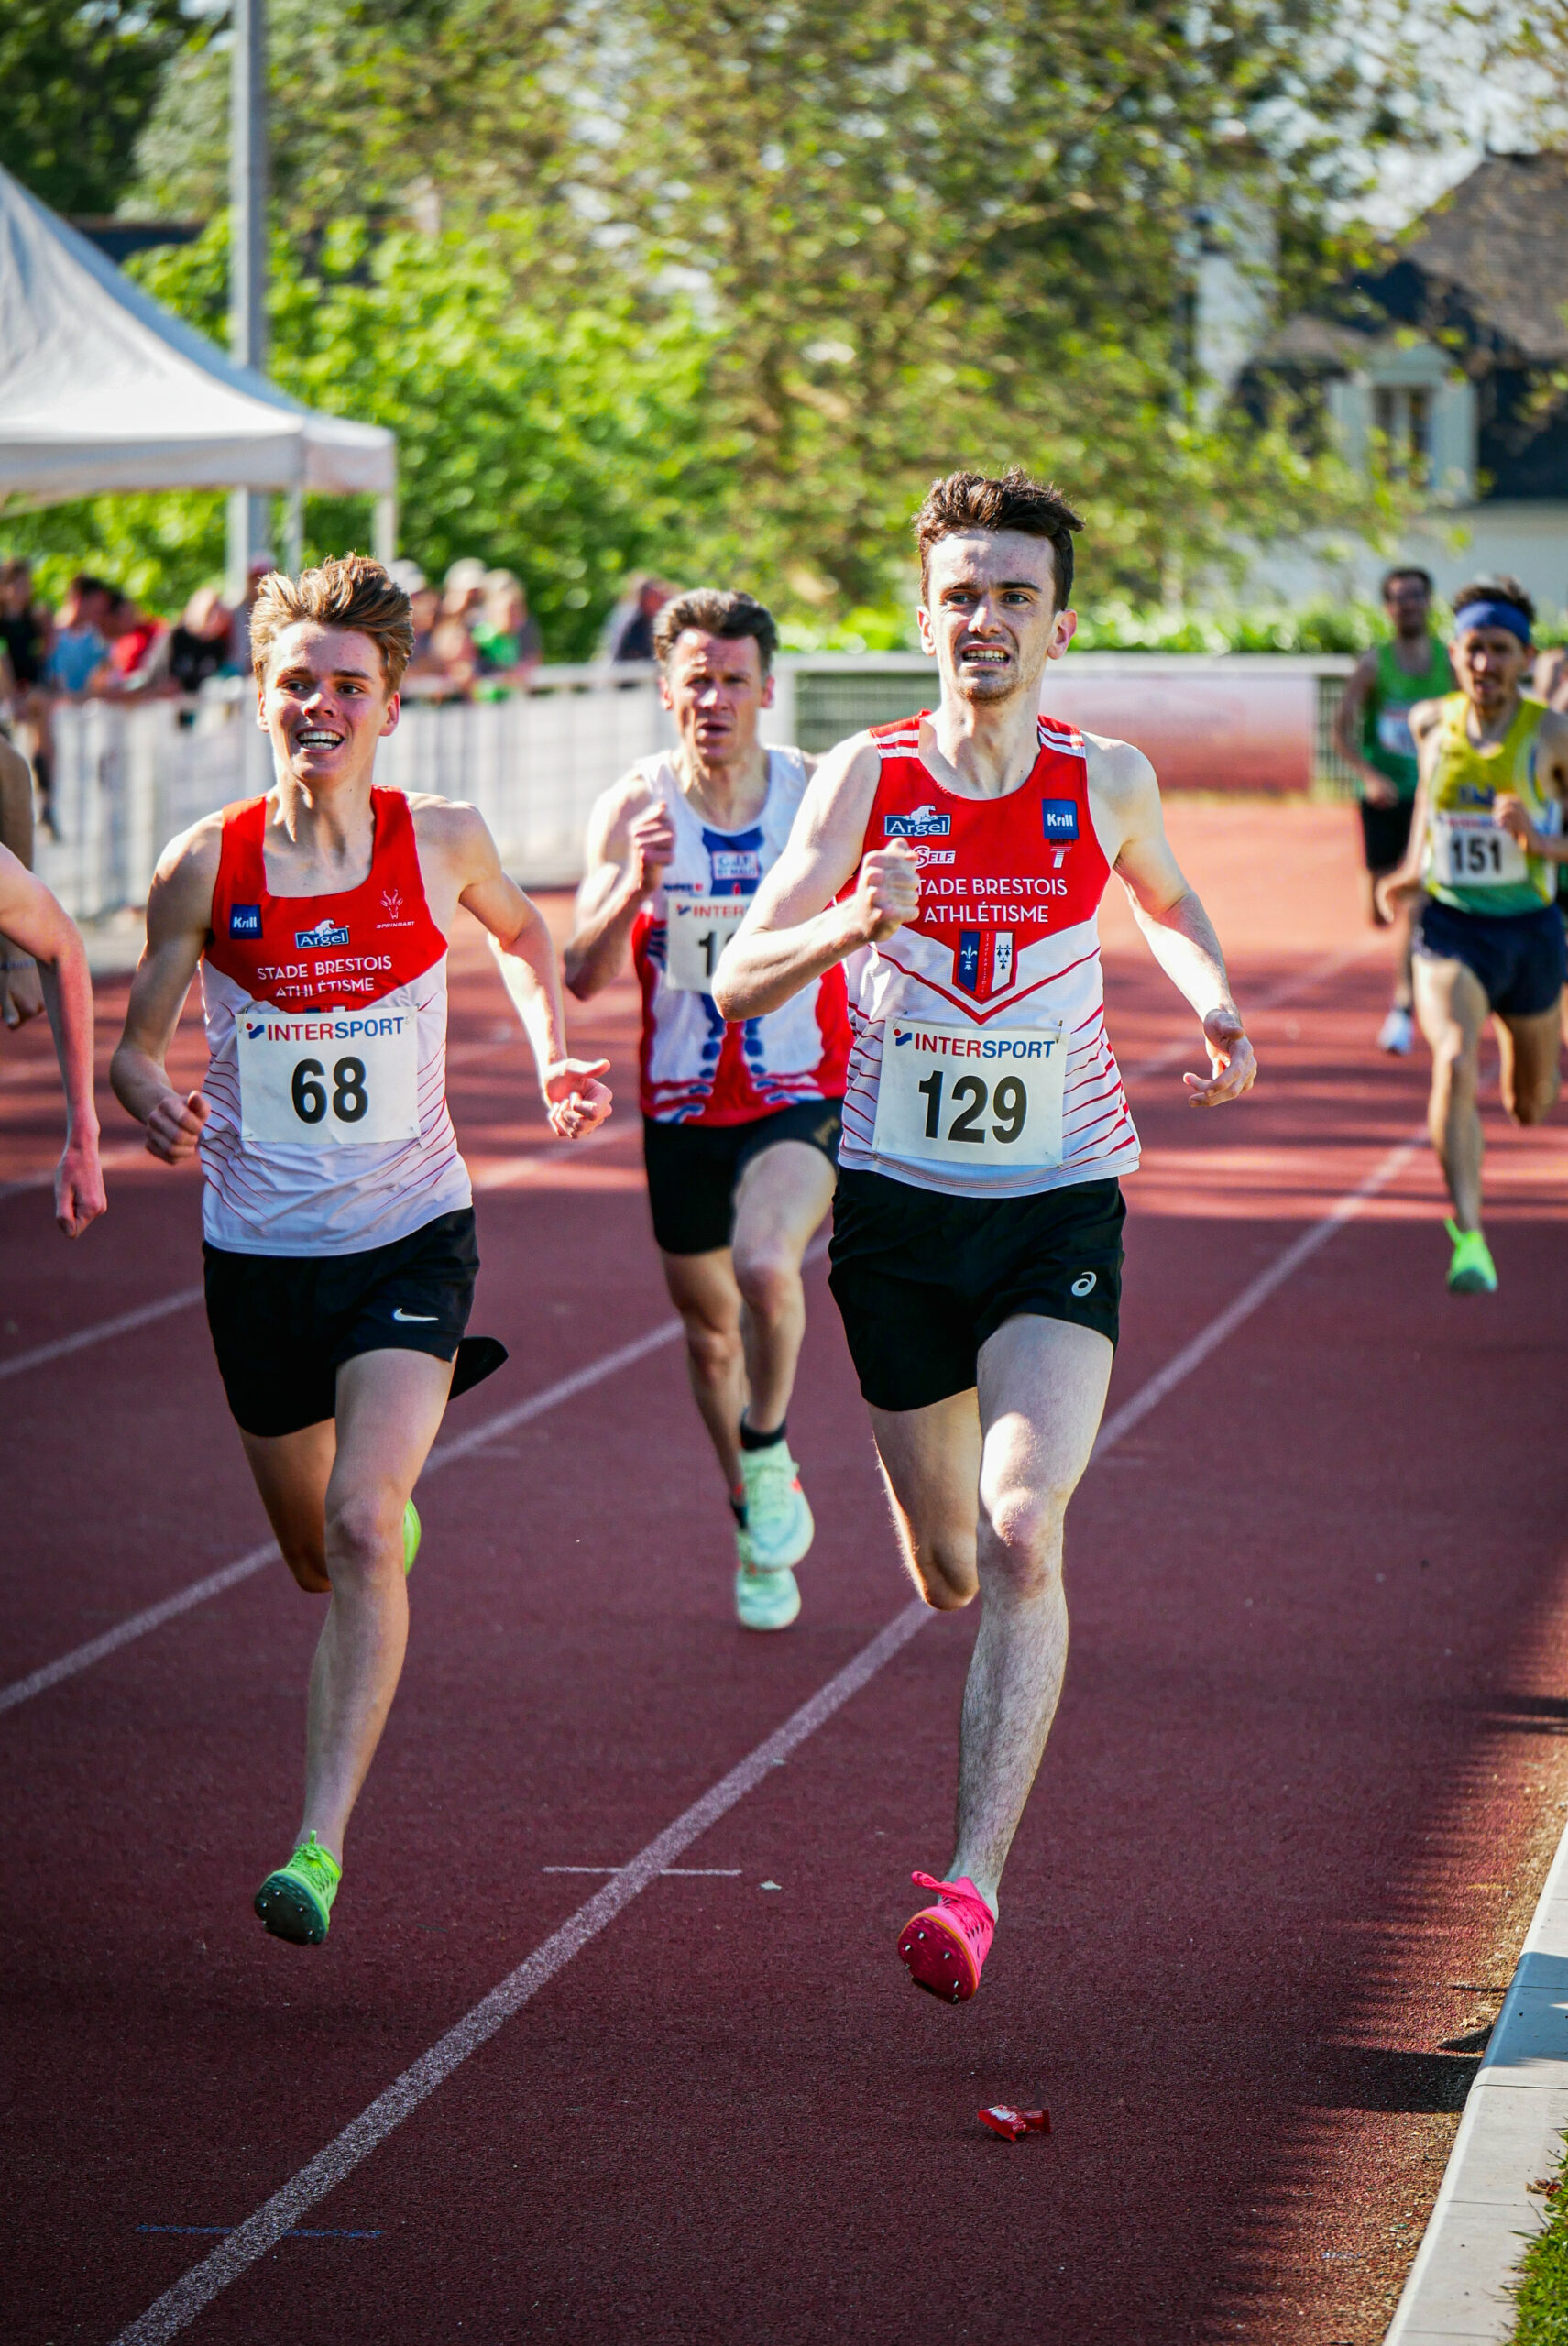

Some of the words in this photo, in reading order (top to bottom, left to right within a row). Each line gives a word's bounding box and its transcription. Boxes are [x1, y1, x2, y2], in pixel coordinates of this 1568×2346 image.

[889, 820, 946, 837] Argel
[1047, 813, 1074, 827] Krill
[1452, 838, 1501, 873] 151
[916, 878, 968, 896] TADE
[972, 878, 1068, 896] BRESTOIS
[693, 904, 751, 917] INTER
[924, 901, 1048, 923] ATHLÉTISME
[233, 916, 257, 928] Krill
[300, 932, 345, 947] Argel
[257, 963, 308, 981] STADE
[314, 955, 392, 976] BRESTOIS
[276, 977, 374, 997] ATHLÉTISME
[268, 1017, 404, 1041] INTERSPORT
[915, 1032, 1055, 1058] INTERSPORT
[291, 1056, 368, 1124] 68
[918, 1069, 1027, 1144] 129
